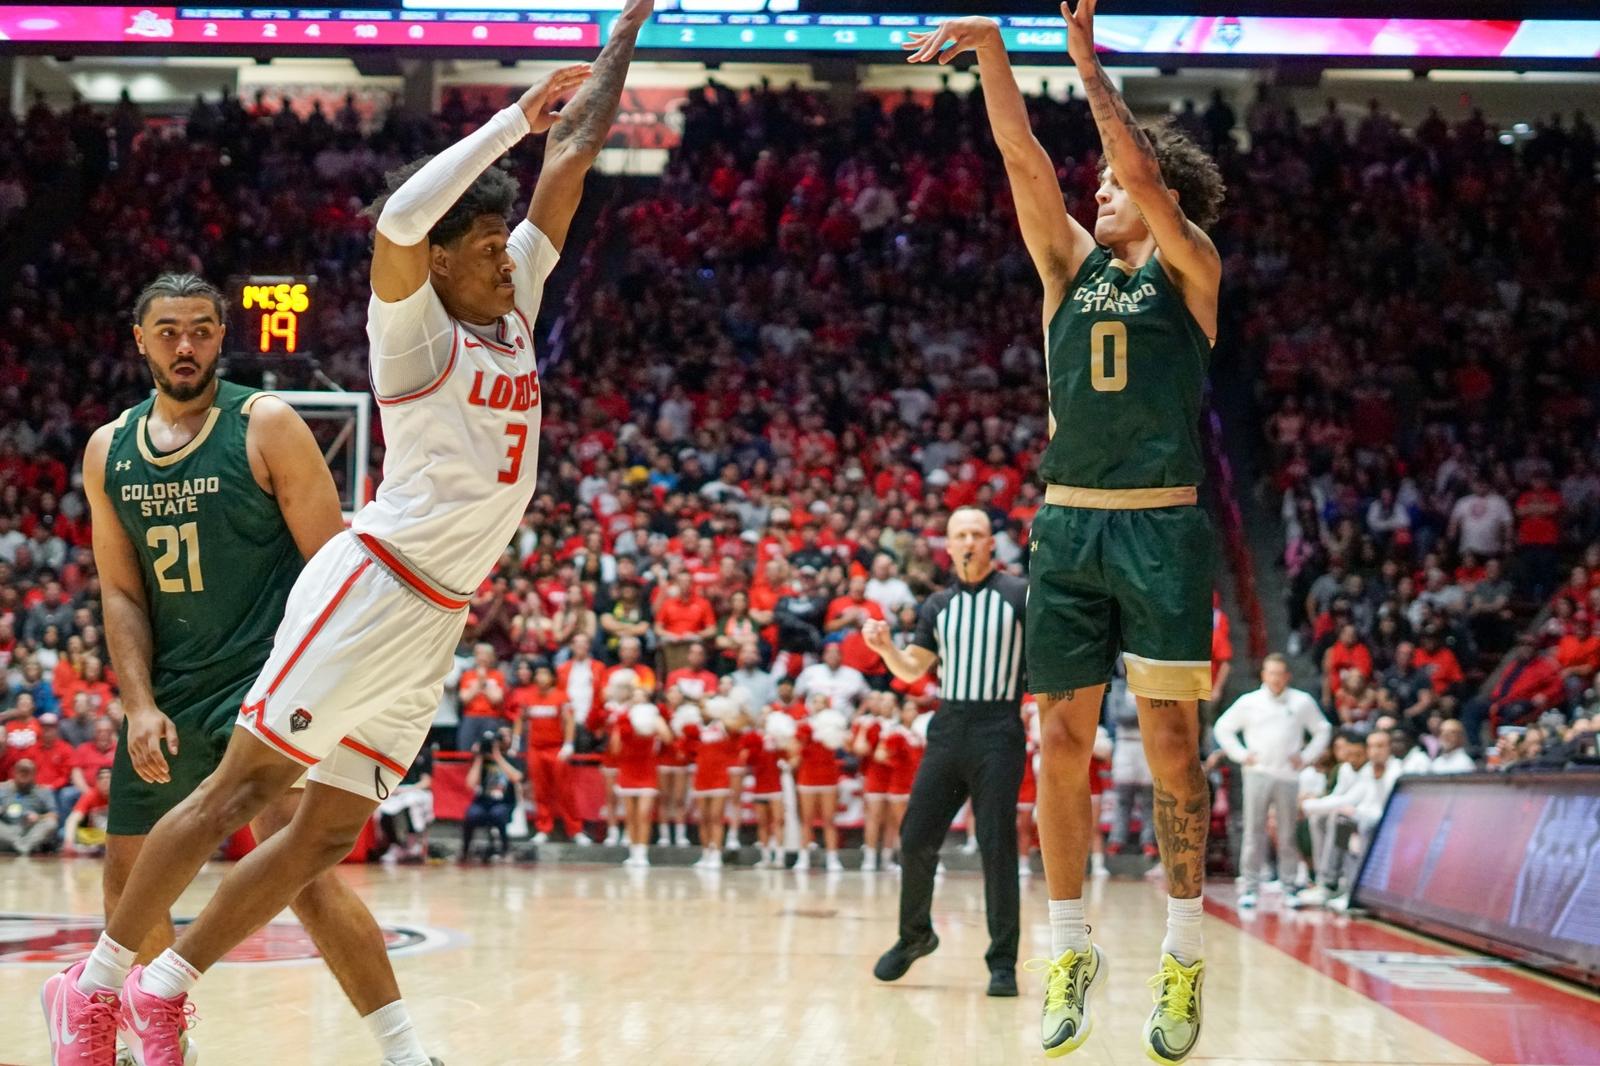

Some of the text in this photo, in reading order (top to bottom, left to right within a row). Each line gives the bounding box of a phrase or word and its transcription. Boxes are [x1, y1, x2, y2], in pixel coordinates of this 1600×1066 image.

[1073, 282, 1157, 304] COORADO
[260, 311, 297, 353] 19
[1091, 321, 1127, 392] 0
[497, 423, 528, 484] 3
[121, 476, 220, 502] COLORADO
[140, 496, 198, 517] STATE
[146, 521, 204, 593] 21
